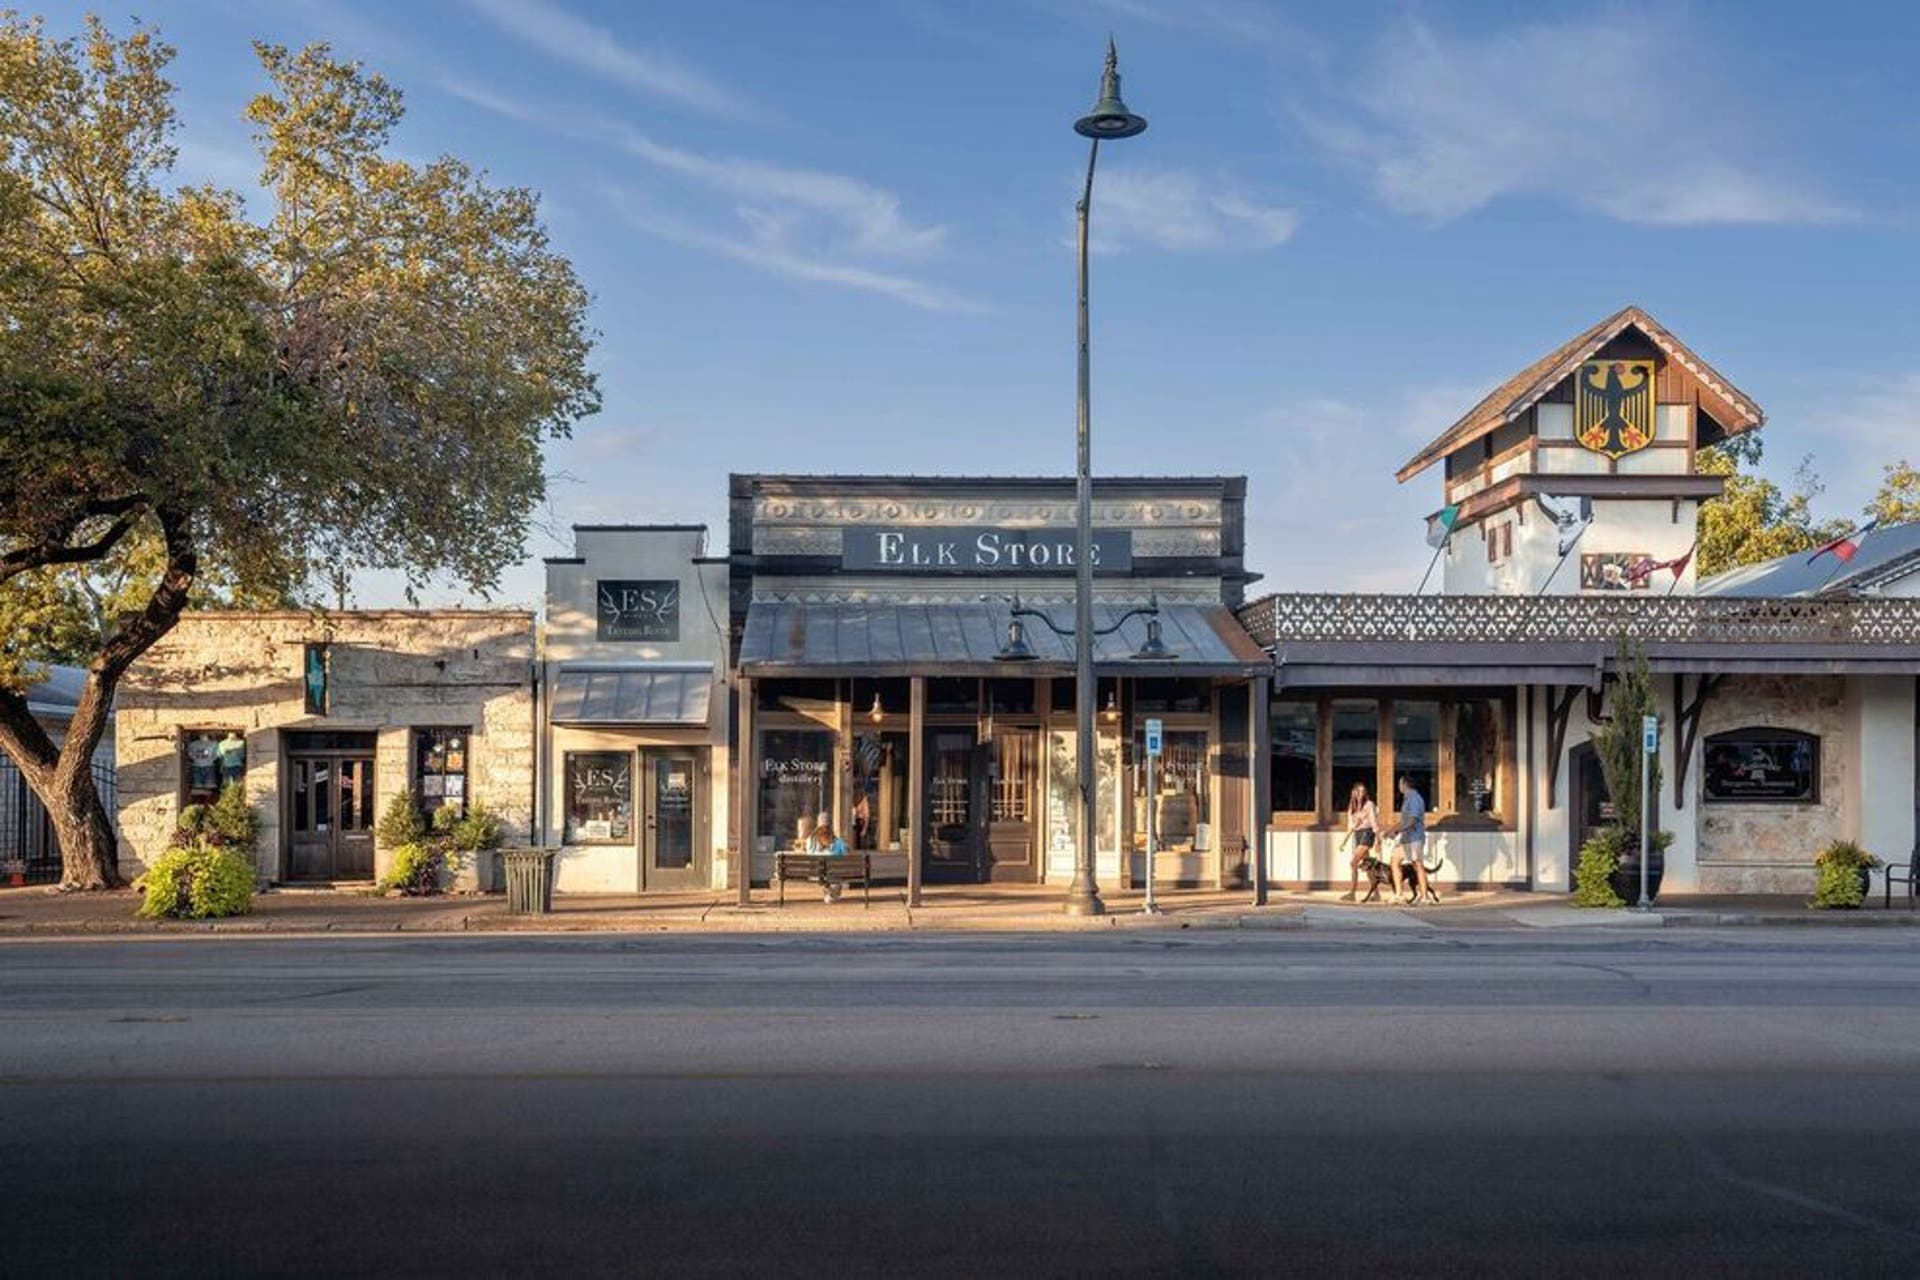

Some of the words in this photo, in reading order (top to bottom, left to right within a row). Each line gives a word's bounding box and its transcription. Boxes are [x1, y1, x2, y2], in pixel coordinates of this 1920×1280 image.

[875, 532, 958, 565] ELK
[622, 589, 657, 612] ES
[587, 769, 614, 787] ES
